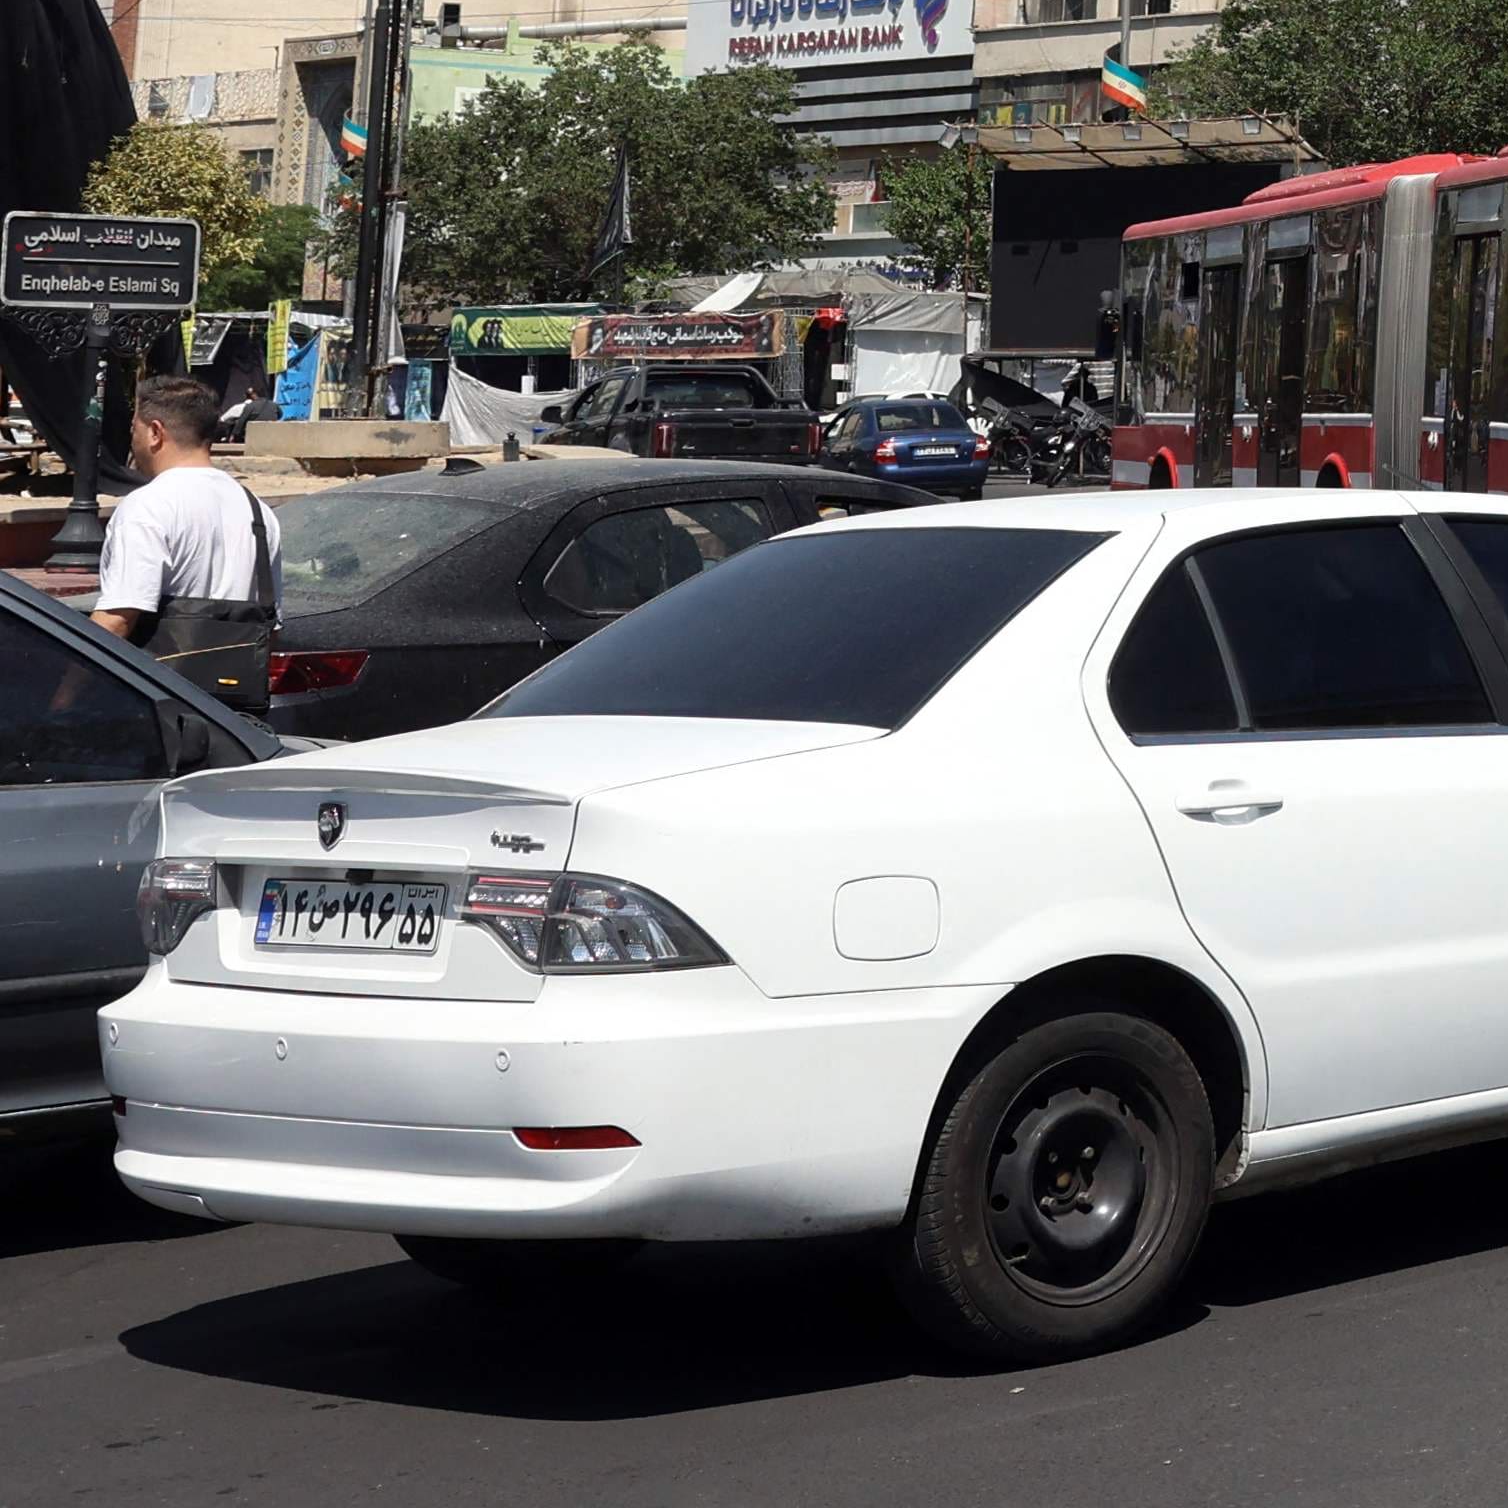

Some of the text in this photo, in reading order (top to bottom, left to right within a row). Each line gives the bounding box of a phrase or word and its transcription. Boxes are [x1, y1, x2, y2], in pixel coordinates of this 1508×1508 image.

[860, 24, 903, 48] BANK
[24, 226, 181, 252] میدان انقلاب اسلامی
[21, 274, 180, 297] Enqhelab-e Eslami Sq
[408, 886, 439, 900] ایران
